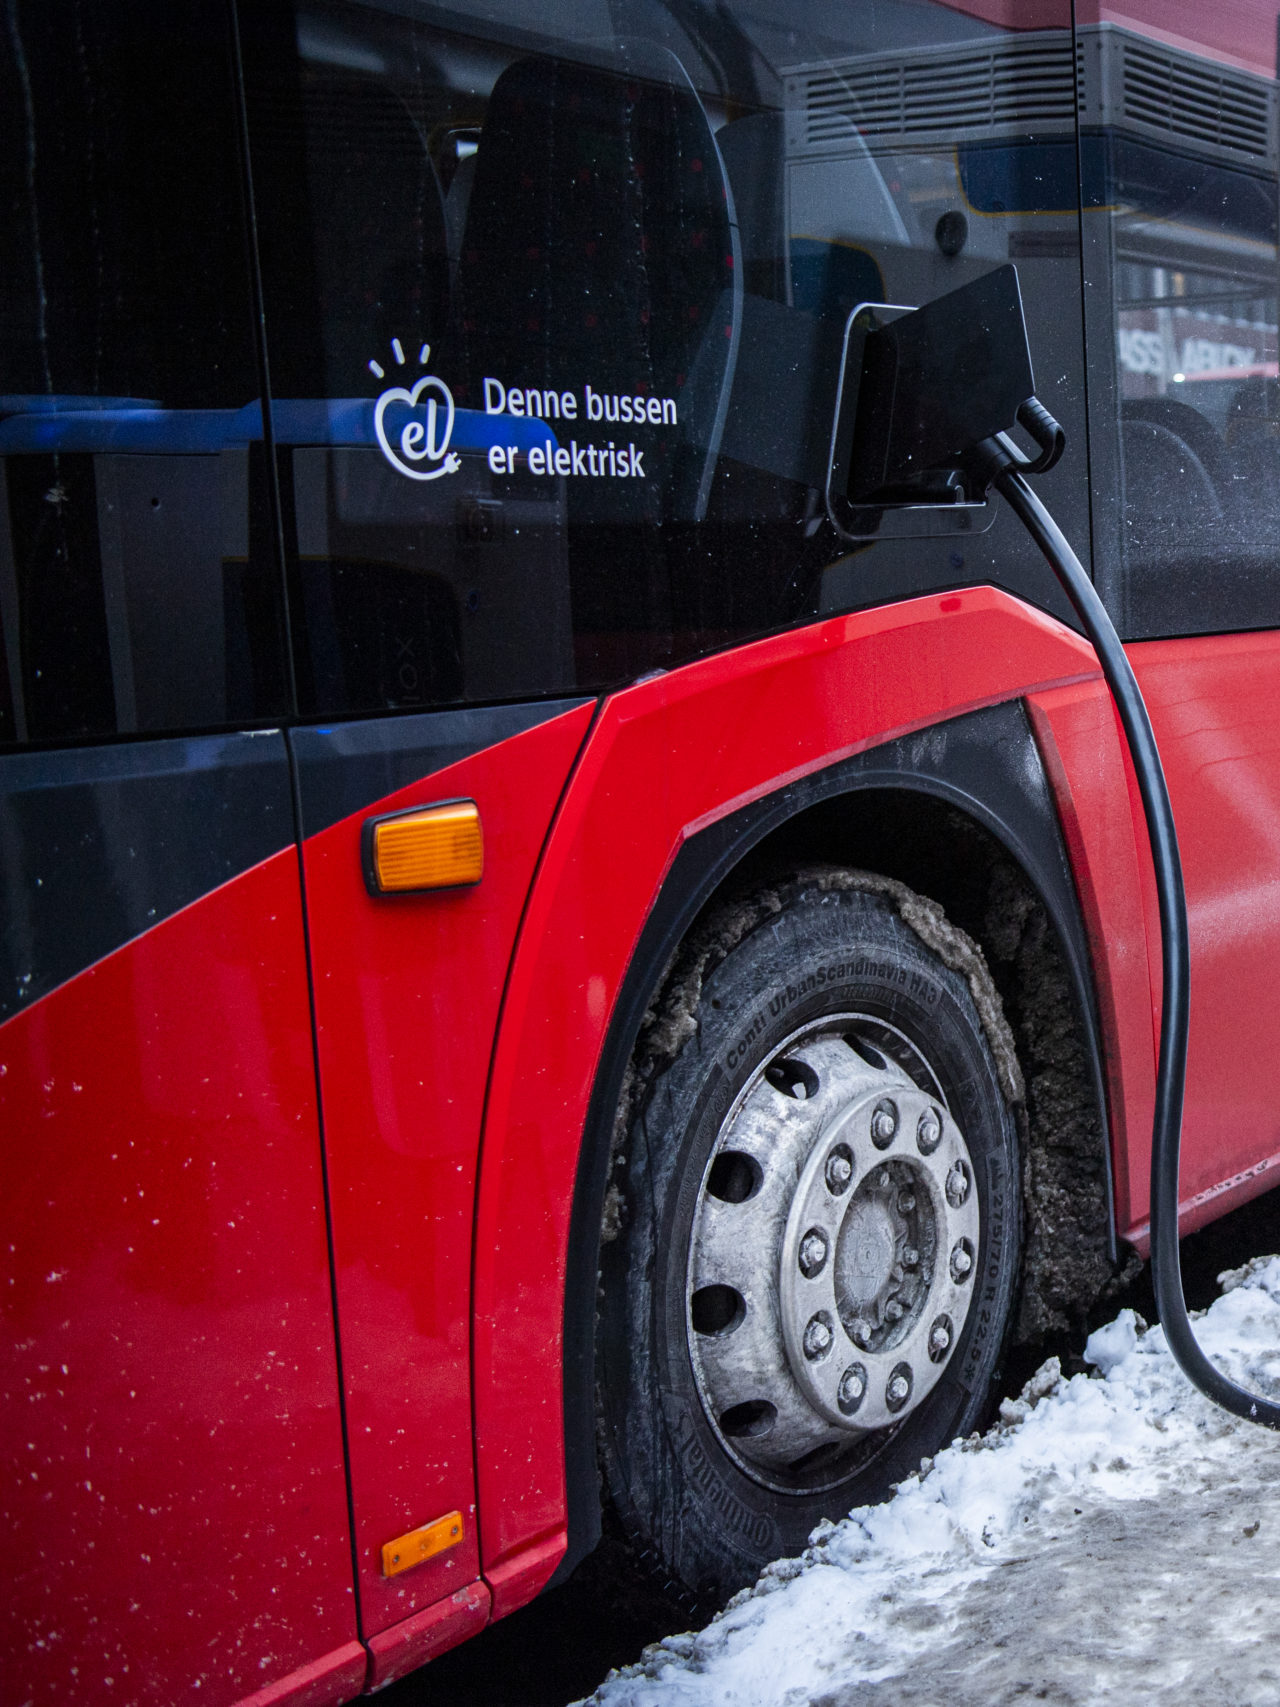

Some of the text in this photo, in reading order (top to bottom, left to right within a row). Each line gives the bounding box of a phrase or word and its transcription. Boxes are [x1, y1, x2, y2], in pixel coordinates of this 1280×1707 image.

[483, 377, 678, 425] Denne bussen
[489, 439, 646, 479] er elektrisk
[726, 1011, 767, 1070] Conti
[910, 972, 937, 1005] HA3
